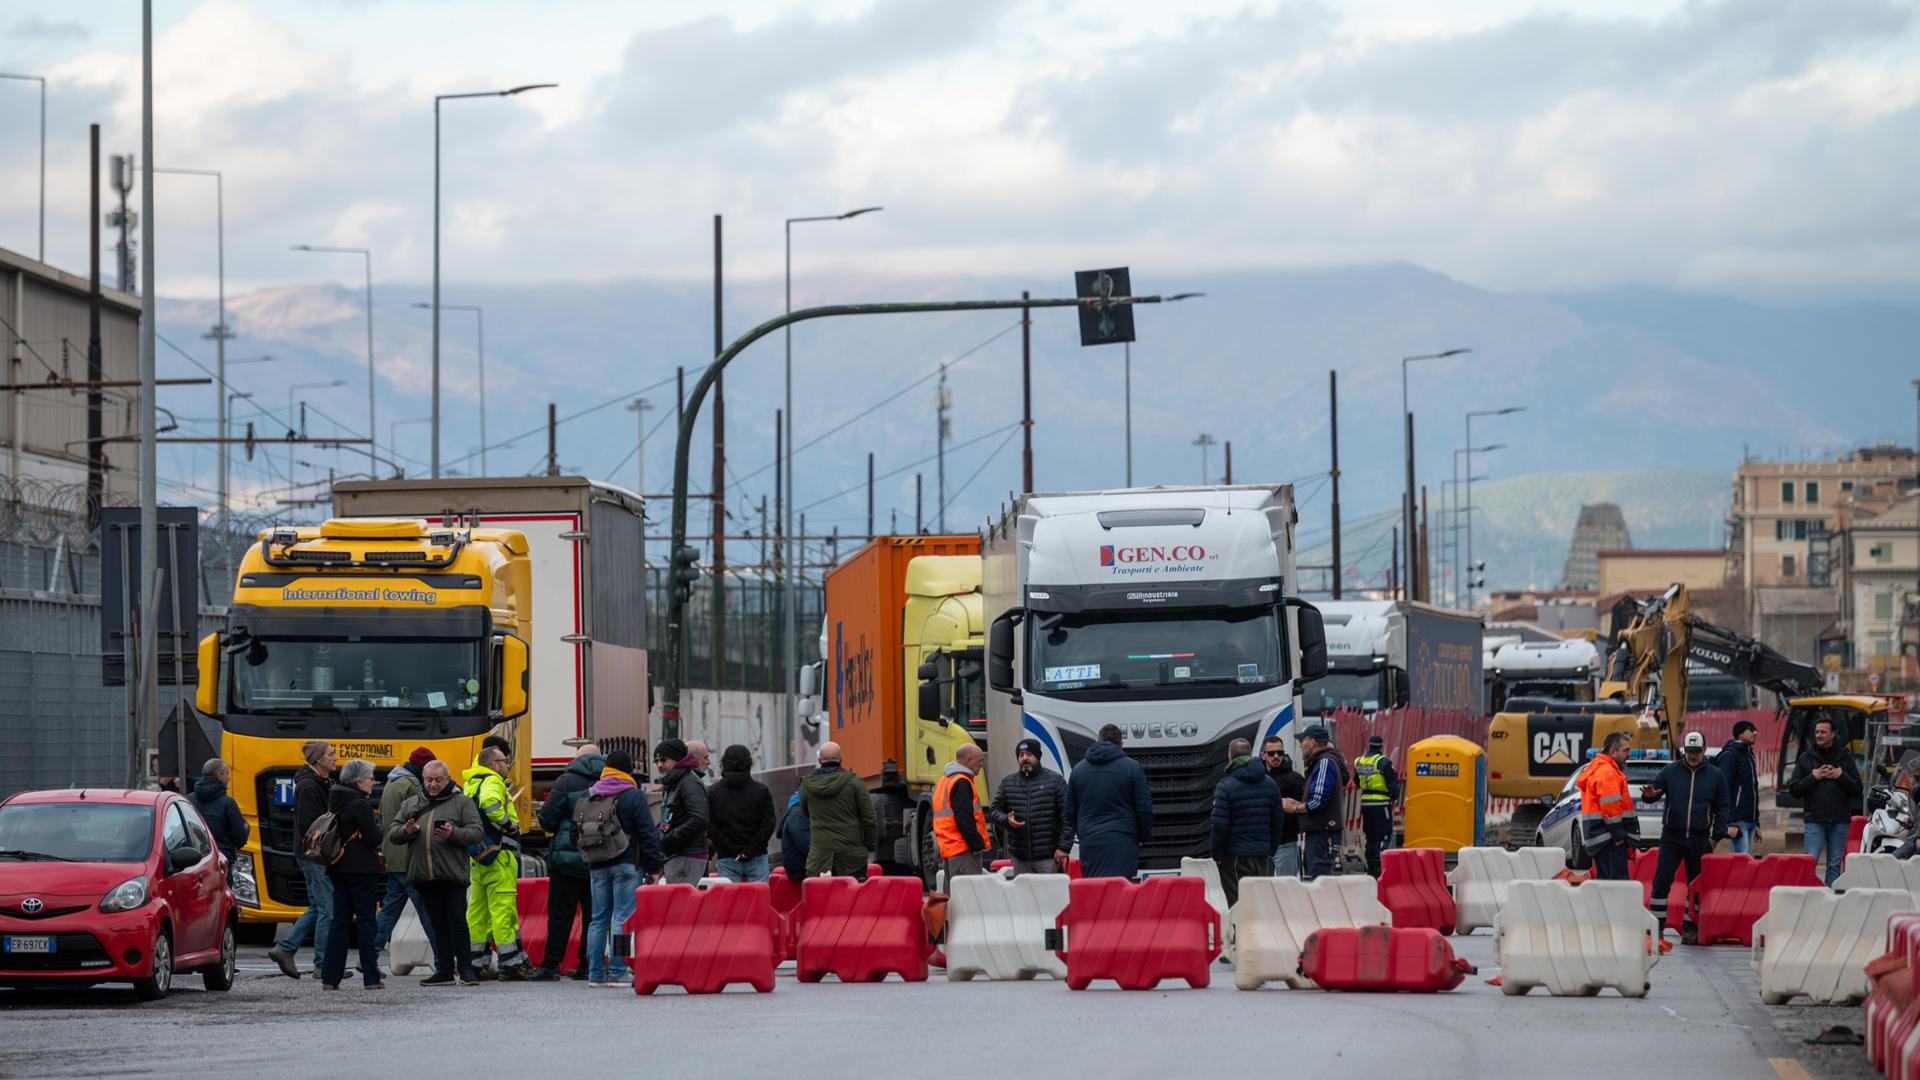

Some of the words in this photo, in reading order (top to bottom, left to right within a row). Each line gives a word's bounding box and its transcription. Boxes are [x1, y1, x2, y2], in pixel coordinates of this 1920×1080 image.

[1117, 546, 1205, 563] GEN.CO
[1112, 565, 1152, 576] Trasporti
[1162, 565, 1204, 573] Ambiente
[282, 588, 380, 601] International
[383, 588, 437, 604] towing
[1054, 666, 1093, 679] ATTI
[1120, 722, 1198, 739] IVECO
[1533, 731, 1584, 765] CAT
